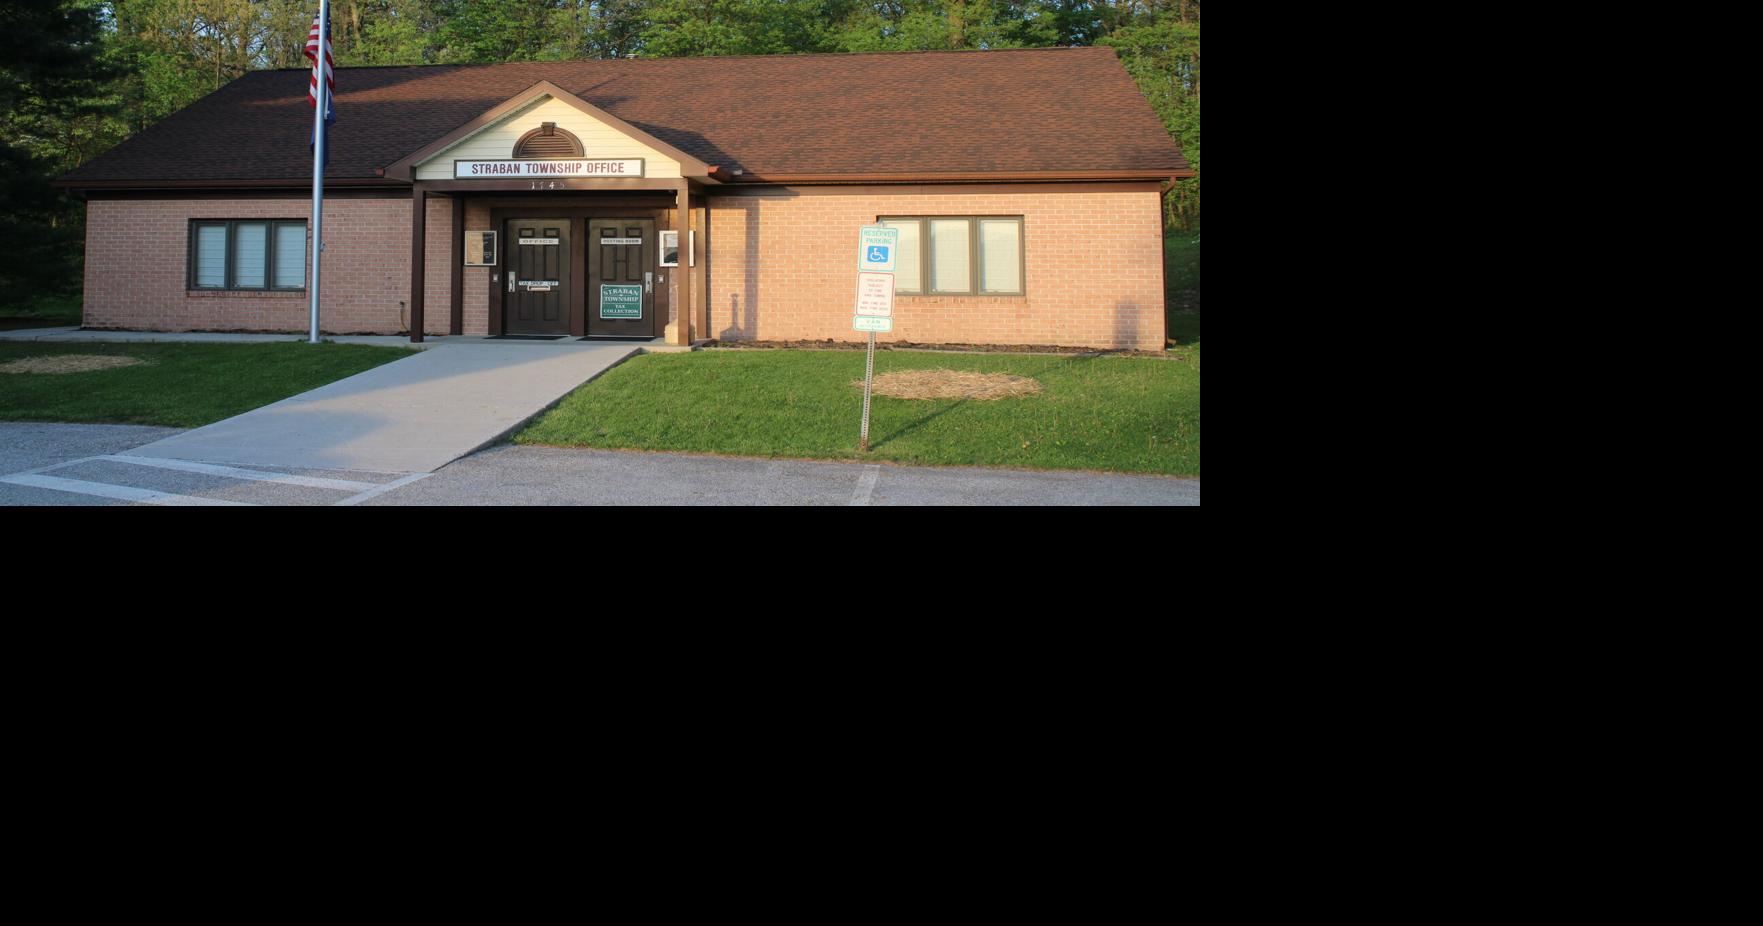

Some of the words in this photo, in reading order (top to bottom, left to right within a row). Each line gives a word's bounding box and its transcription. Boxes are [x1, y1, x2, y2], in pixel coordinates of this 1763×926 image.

[471, 163, 521, 175] STRABAN
[525, 162, 582, 174] TOWNSHIP
[586, 162, 625, 173] OFFICE
[603, 288, 640, 296] STRABAN
